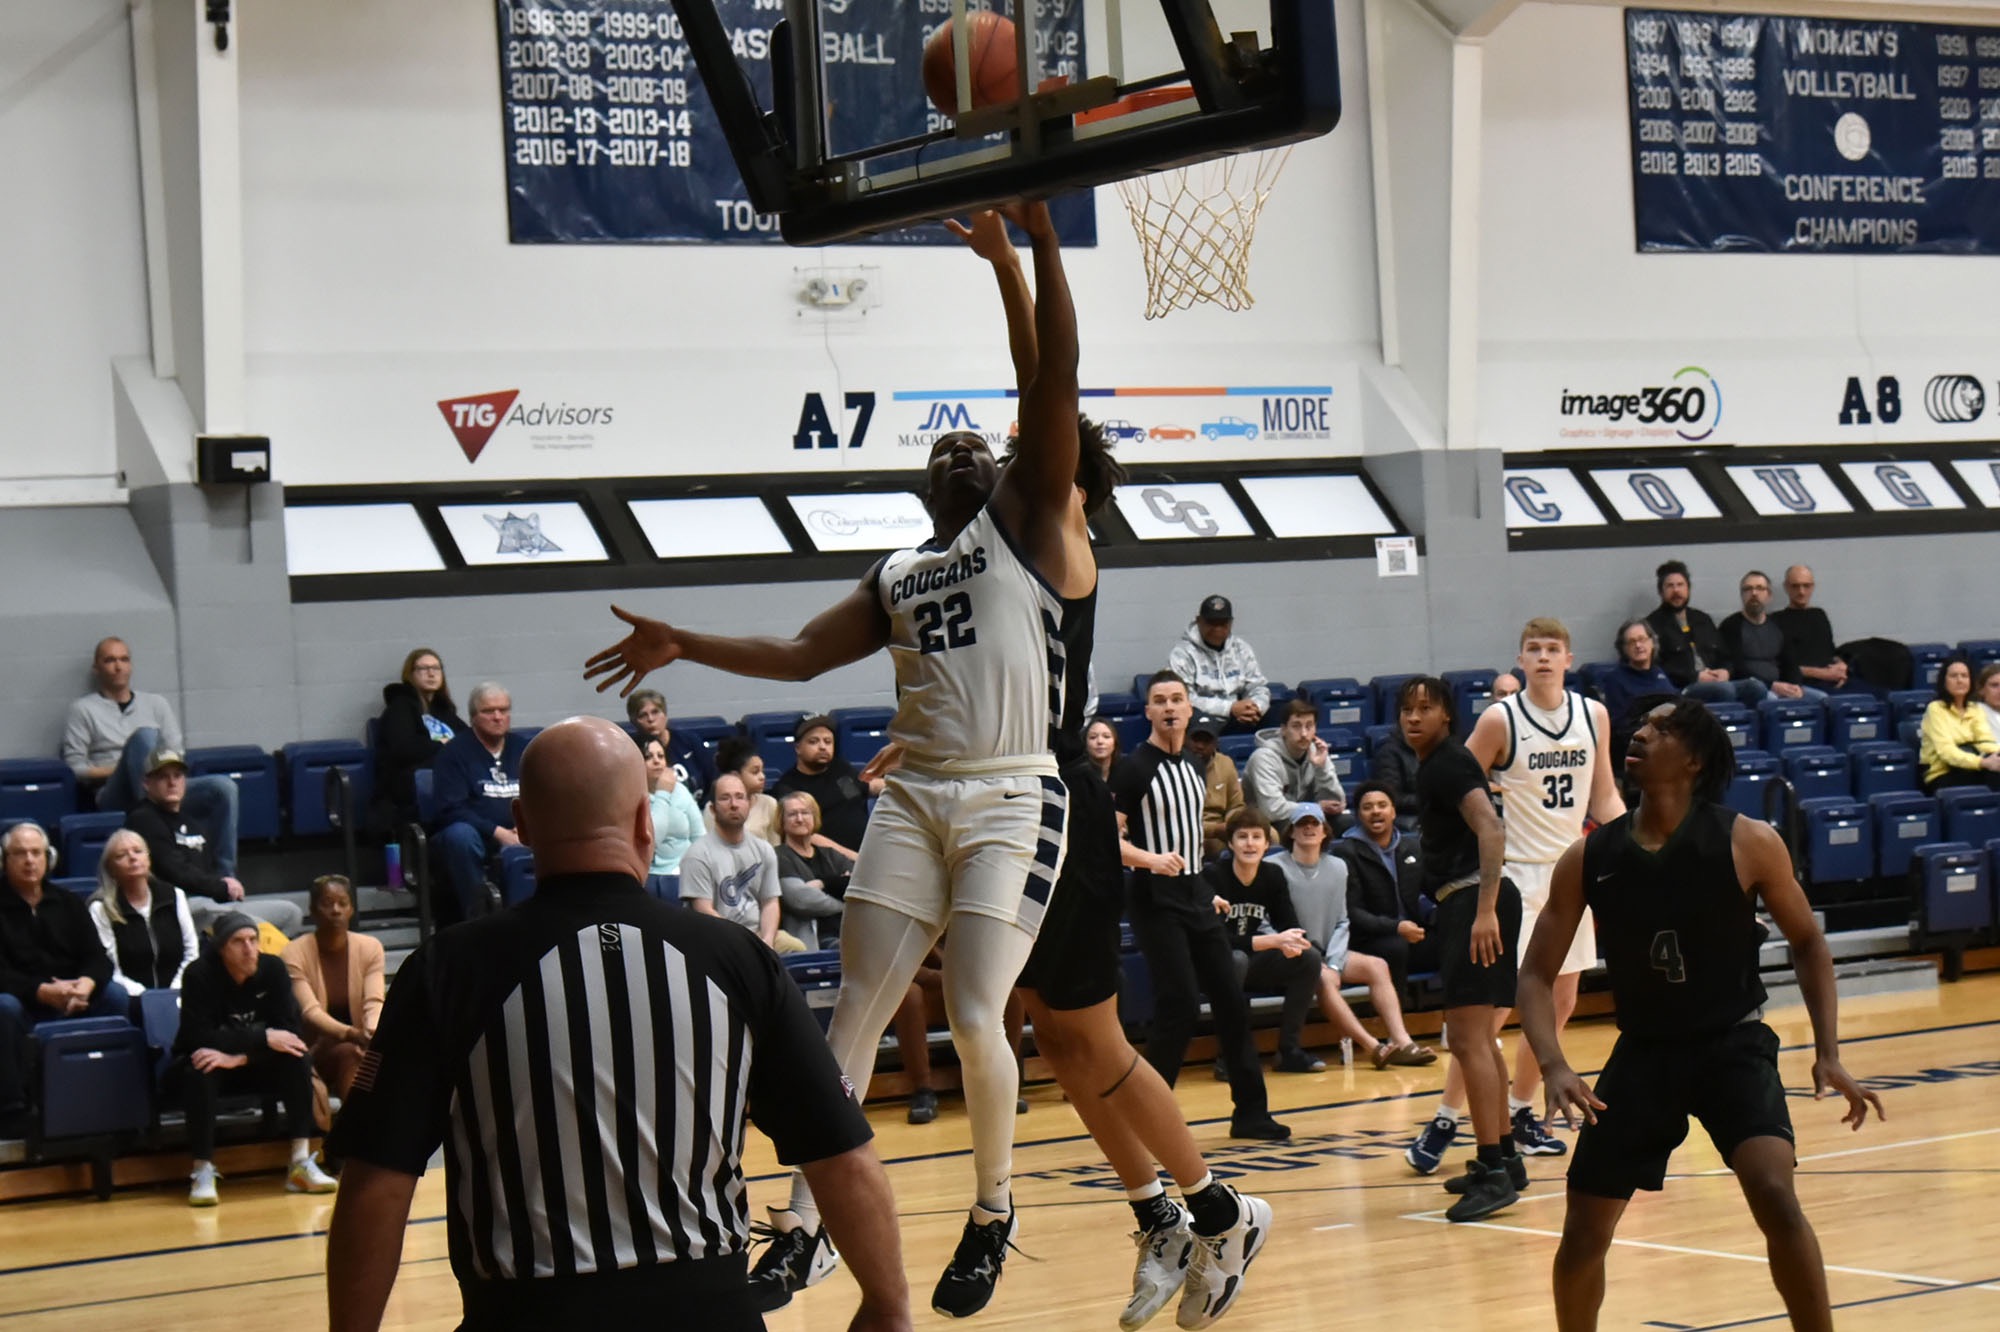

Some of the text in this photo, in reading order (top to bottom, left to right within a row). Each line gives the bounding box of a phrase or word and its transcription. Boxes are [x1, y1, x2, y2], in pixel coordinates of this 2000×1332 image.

[509, 9, 684, 39] 1998-99 1999-00
[510, 41, 685, 71] 2002-03 2003-04
[1799, 27, 1898, 57] WOMEN'S
[512, 73, 687, 104] 2007-08 2008-09
[1783, 69, 1916, 100] VOLLEYBALL
[1938, 66, 1969, 88] 1997
[1638, 87, 1671, 109] 2000
[514, 106, 691, 136] 2012-13 2013-14
[1682, 121, 1716, 143] 2007
[516, 139, 690, 166] 2016-17 2017-18
[1641, 152, 1761, 175] 2012 2013 2015
[1785, 175, 1926, 203] CONFERENCE
[1795, 218, 1918, 246] CHAMPIONS
[452, 402, 614, 428] TIG Advisors
[1263, 397, 1331, 432] MORE
[1561, 386, 1706, 423] image360
[1839, 376, 1902, 425] A8
[793, 391, 876, 449] A7
[891, 546, 987, 606] COUGARS
[913, 591, 977, 655] 22
[1528, 750, 1586, 770] COUGARS
[1542, 774, 1574, 809] 32
[1650, 929, 1686, 983] 4
